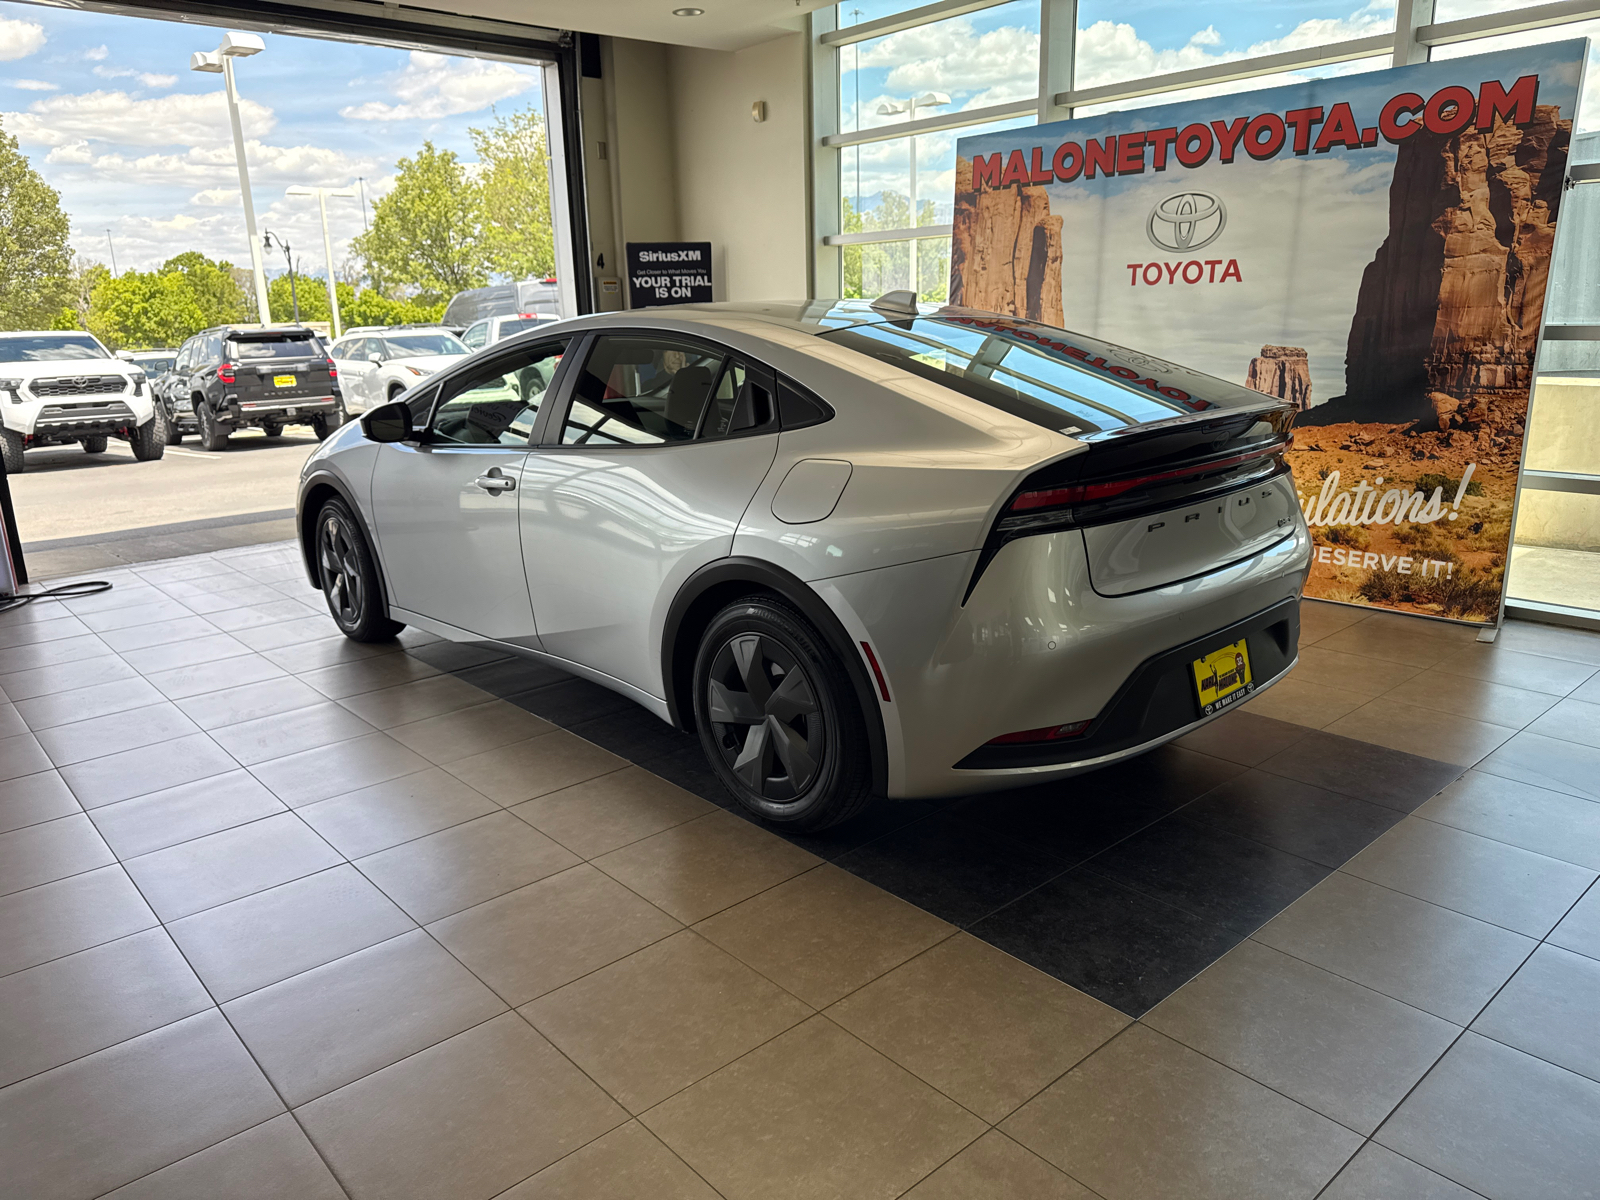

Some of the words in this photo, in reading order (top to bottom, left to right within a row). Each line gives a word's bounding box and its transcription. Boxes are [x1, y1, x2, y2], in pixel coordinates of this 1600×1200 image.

[972, 74, 1539, 189] MALONETOYOTA.COM
[597, 253, 605, 269] 4
[638, 250, 701, 262] SiriusXM
[1127, 258, 1242, 287] TOYOTA
[633, 277, 670, 288] YOUR
[673, 276, 711, 286] TRIAL
[656, 288, 668, 298] IS
[671, 287, 691, 297] ON
[1148, 488, 1272, 532] PRIUS
[1421, 559, 1454, 580] IT!
